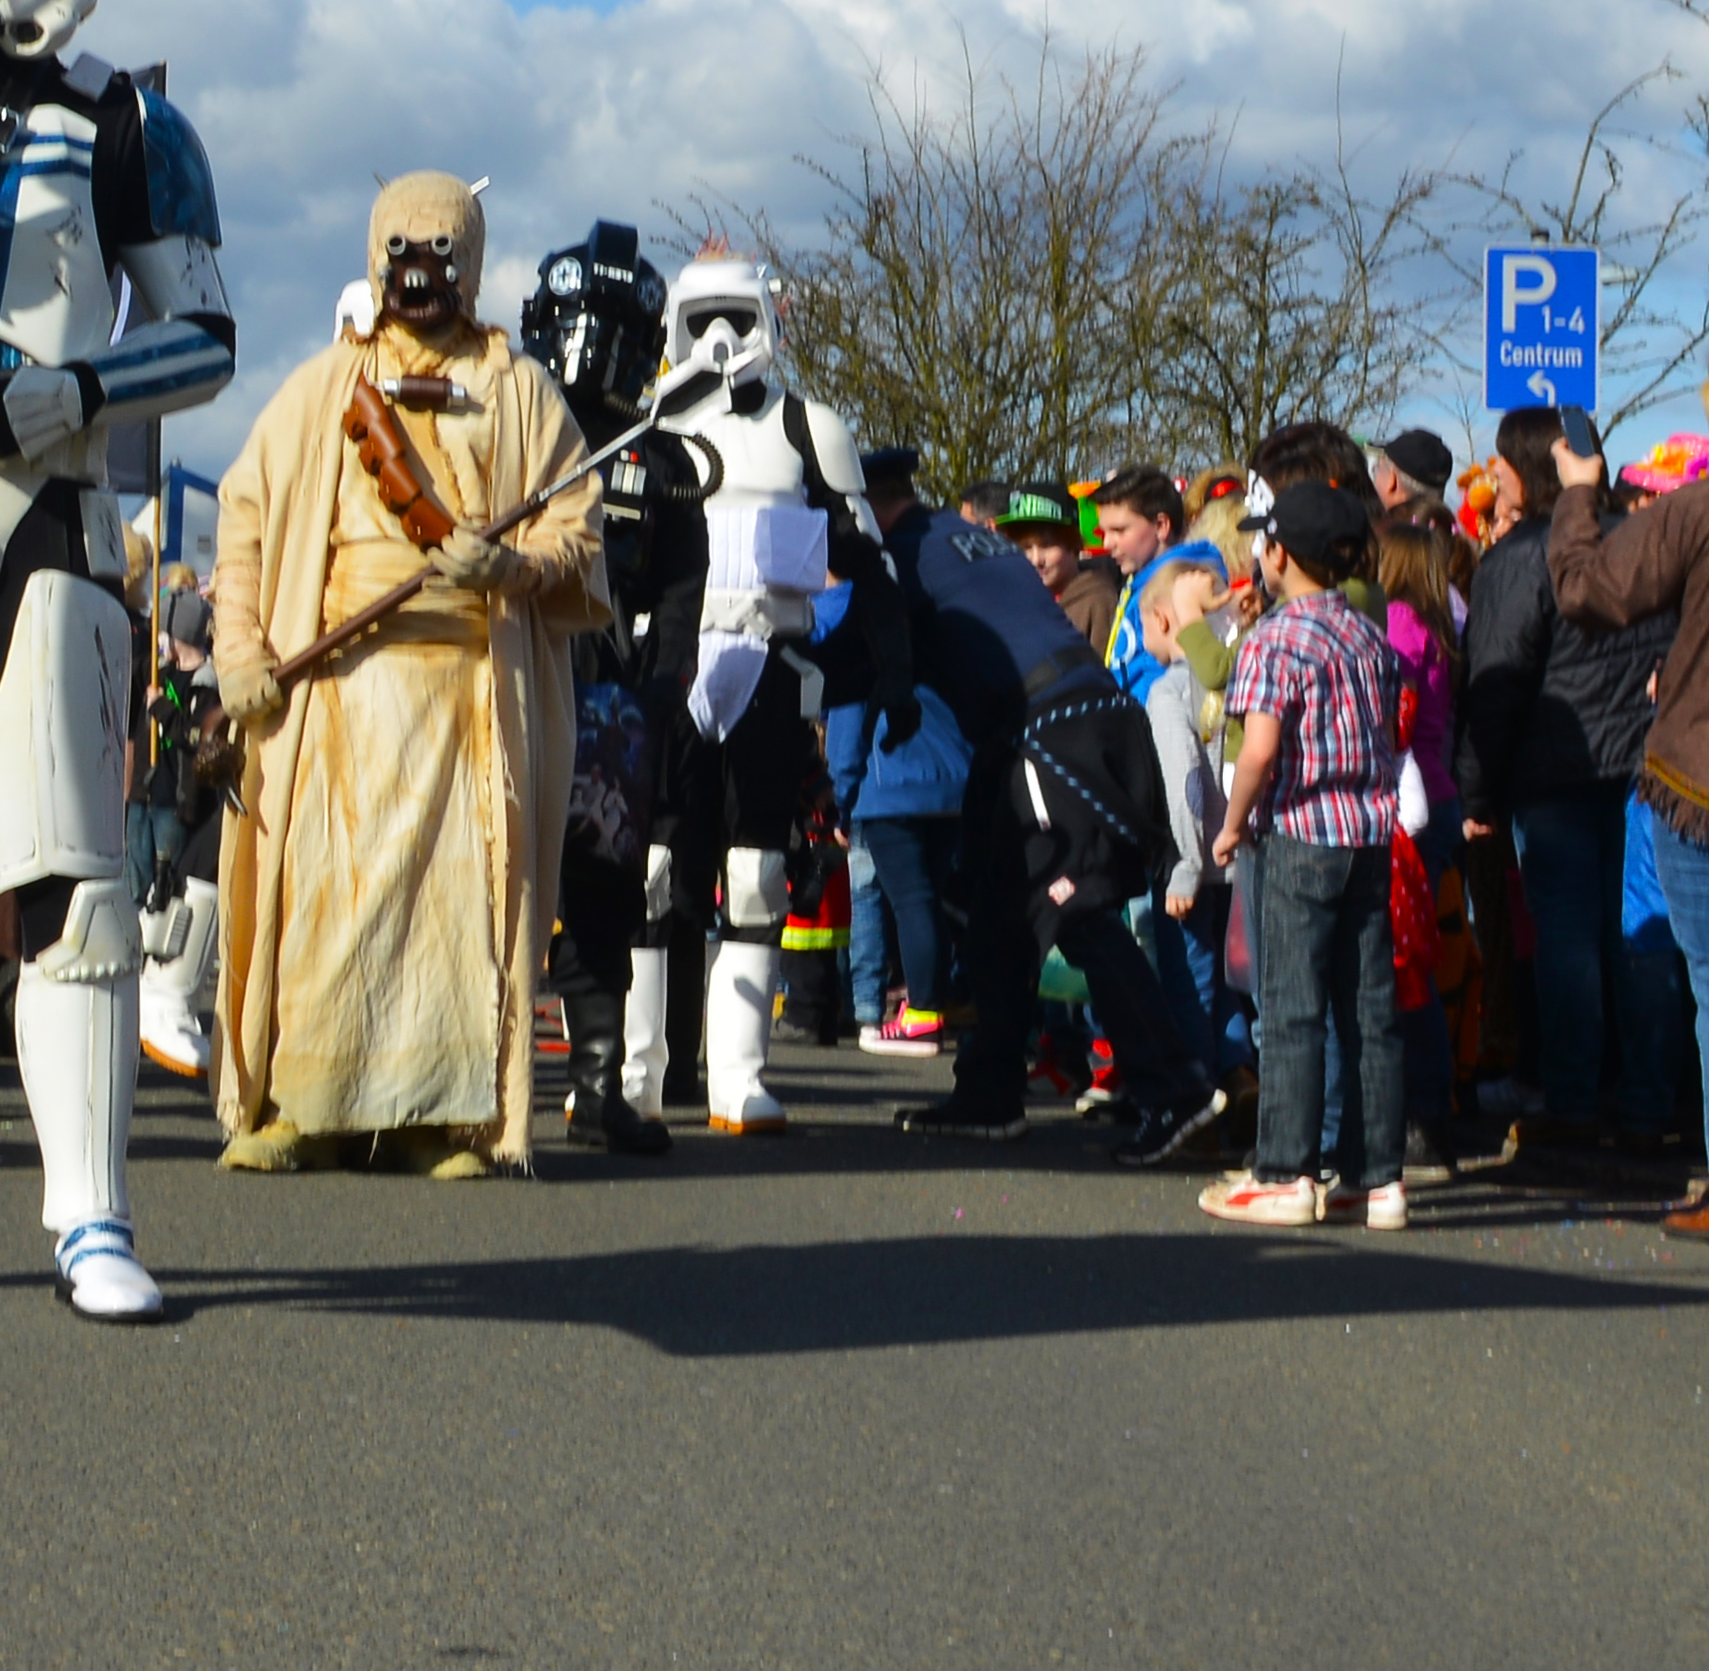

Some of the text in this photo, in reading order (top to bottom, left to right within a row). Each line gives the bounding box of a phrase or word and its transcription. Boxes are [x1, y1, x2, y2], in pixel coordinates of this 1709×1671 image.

[1501, 254, 1586, 335] P 1-4
[1500, 339, 1583, 368] Centrum
